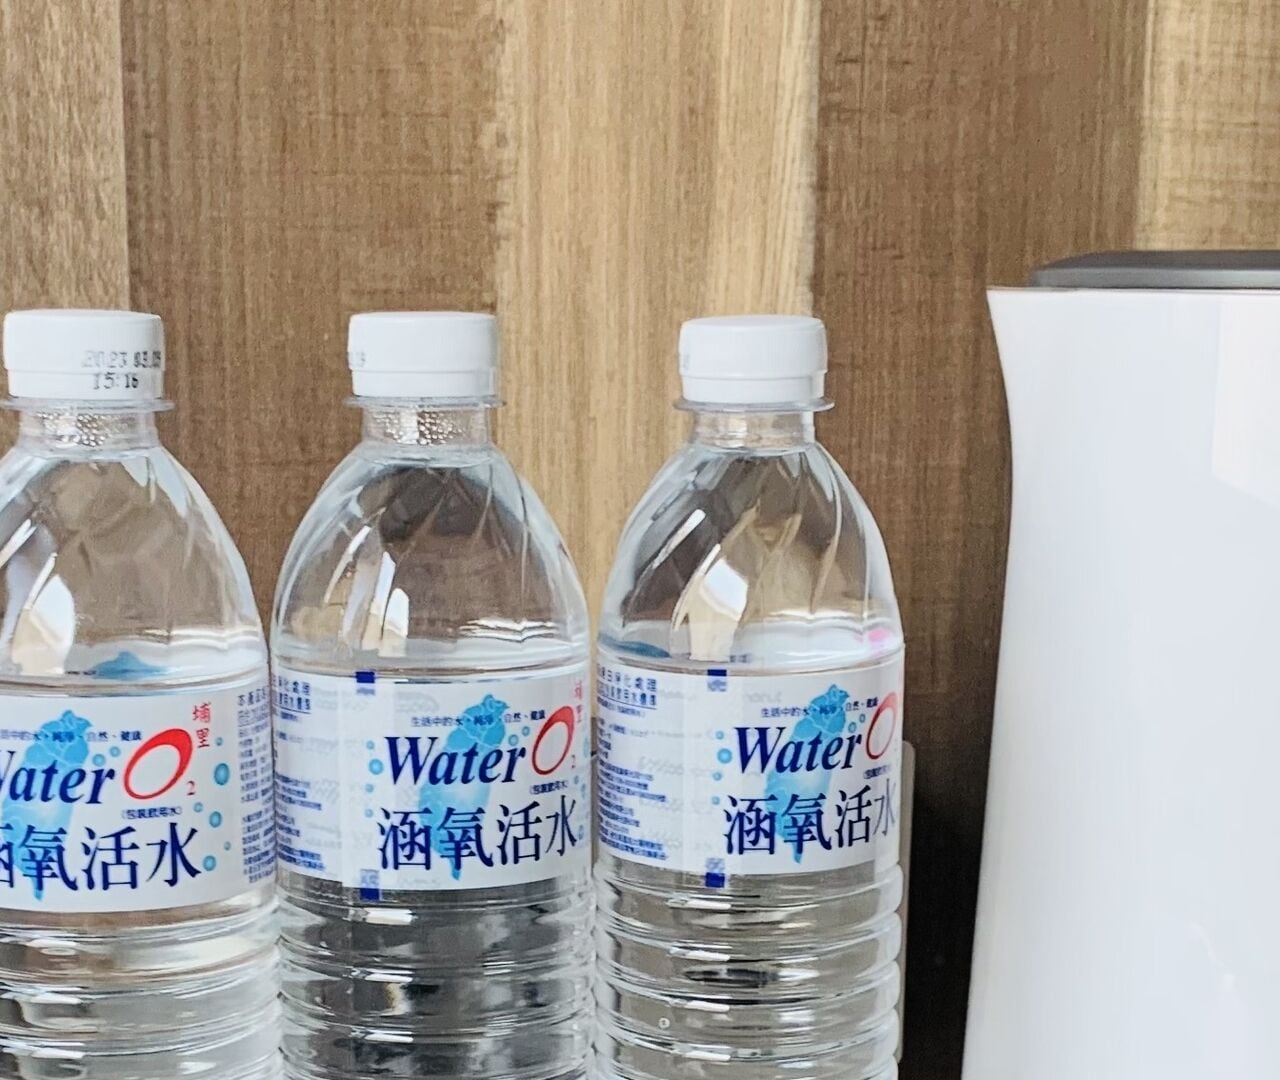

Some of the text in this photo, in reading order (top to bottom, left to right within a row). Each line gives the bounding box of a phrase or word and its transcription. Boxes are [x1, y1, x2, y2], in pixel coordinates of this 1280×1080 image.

[385, 736, 527, 786] Water
[734, 726, 863, 774] Water
[376, 794, 578, 872] 涵氧活水
[723, 778, 897, 856] 涵氧活水
